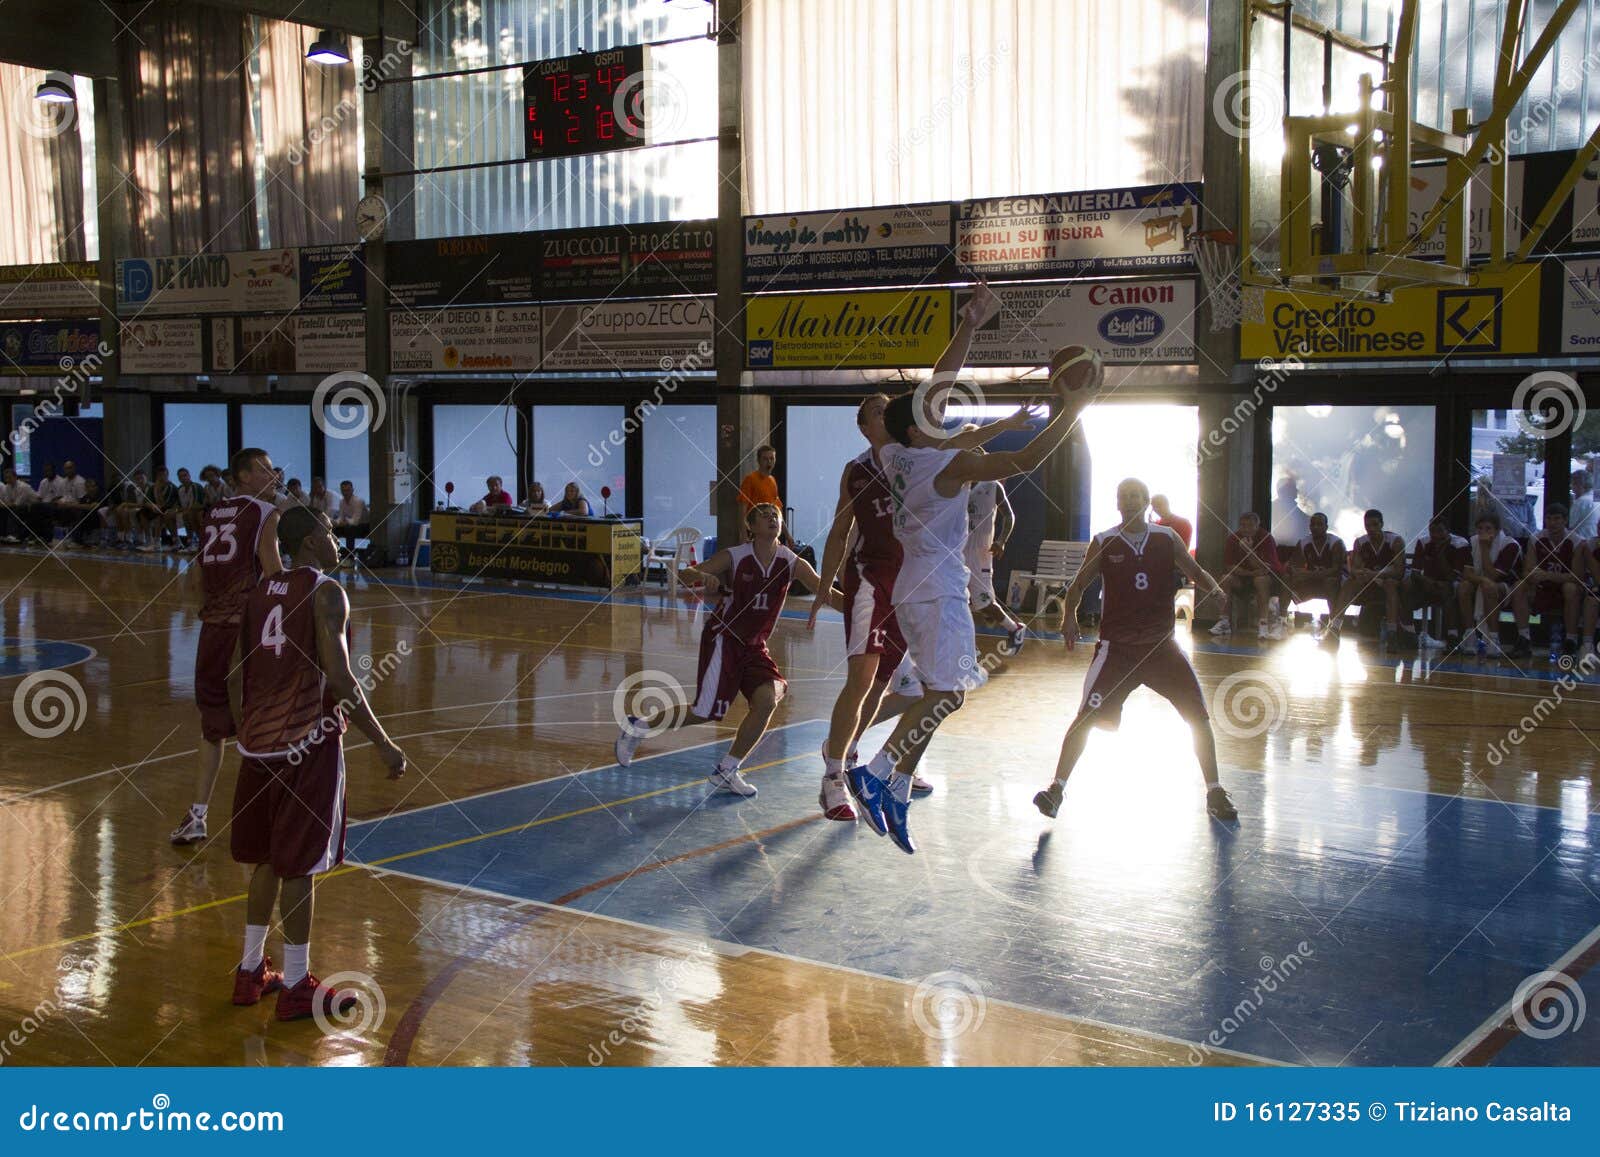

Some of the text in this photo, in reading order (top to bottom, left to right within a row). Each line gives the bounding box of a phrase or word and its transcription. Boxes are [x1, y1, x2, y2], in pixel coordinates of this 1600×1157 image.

[594, 50, 624, 66] OSPITI
[540, 60, 569, 75] LOCALI
[959, 191, 1136, 219] FALEGNAMERIA
[959, 220, 1007, 230] SPEZIALE
[1010, 216, 1063, 227] MARCELLO
[1077, 212, 1111, 222] FIGLIO
[629, 230, 713, 252] PROGETTO
[959, 226, 1104, 246] MOBILI SU MISURA
[543, 236, 620, 258] ZUCCOLI
[959, 246, 1056, 263] SERRAMENTI
[746, 257, 777, 268] AGENZIA
[779, 255, 804, 266] VIAGGI
[809, 252, 853, 265] MORBEGNO
[959, 265, 972, 274] Via
[974, 263, 1001, 273] Merizzi
[1003, 262, 1018, 272] 124
[1025, 260, 1075, 270] MORBEGNO
[1103, 257, 1133, 267] tel./fax
[1135, 256, 1158, 266] 0342
[156, 258, 175, 290] DE
[178, 255, 230, 289] PIANTO
[248, 279, 272, 289] OKAY
[1000, 288, 1072, 300] COMMERCIALE
[1088, 284, 1175, 306] Canon
[1000, 300, 1044, 309] ARTICOLI
[391, 312, 445, 326] PASSERINI
[447, 310, 481, 324] DIEGO
[485, 311, 492, 323] &
[497, 310, 508, 322] C.
[1000, 310, 1038, 319] TECNICI
[1272, 301, 1376, 329] Credito
[1272, 326, 1425, 354] Valtellinese
[1022, 349, 1038, 360] FAX
[1112, 348, 1137, 359] TUTTO
[1140, 347, 1154, 358] PER
[1156, 345, 1195, 358] L'UFFICIO
[202, 522, 238, 563] 23
[509, 555, 570, 576] Morbegno
[1135, 572, 1149, 590] 8
[752, 593, 769, 610] 11
[261, 603, 287, 657] 4
[1088, 692, 1103, 708] 8
